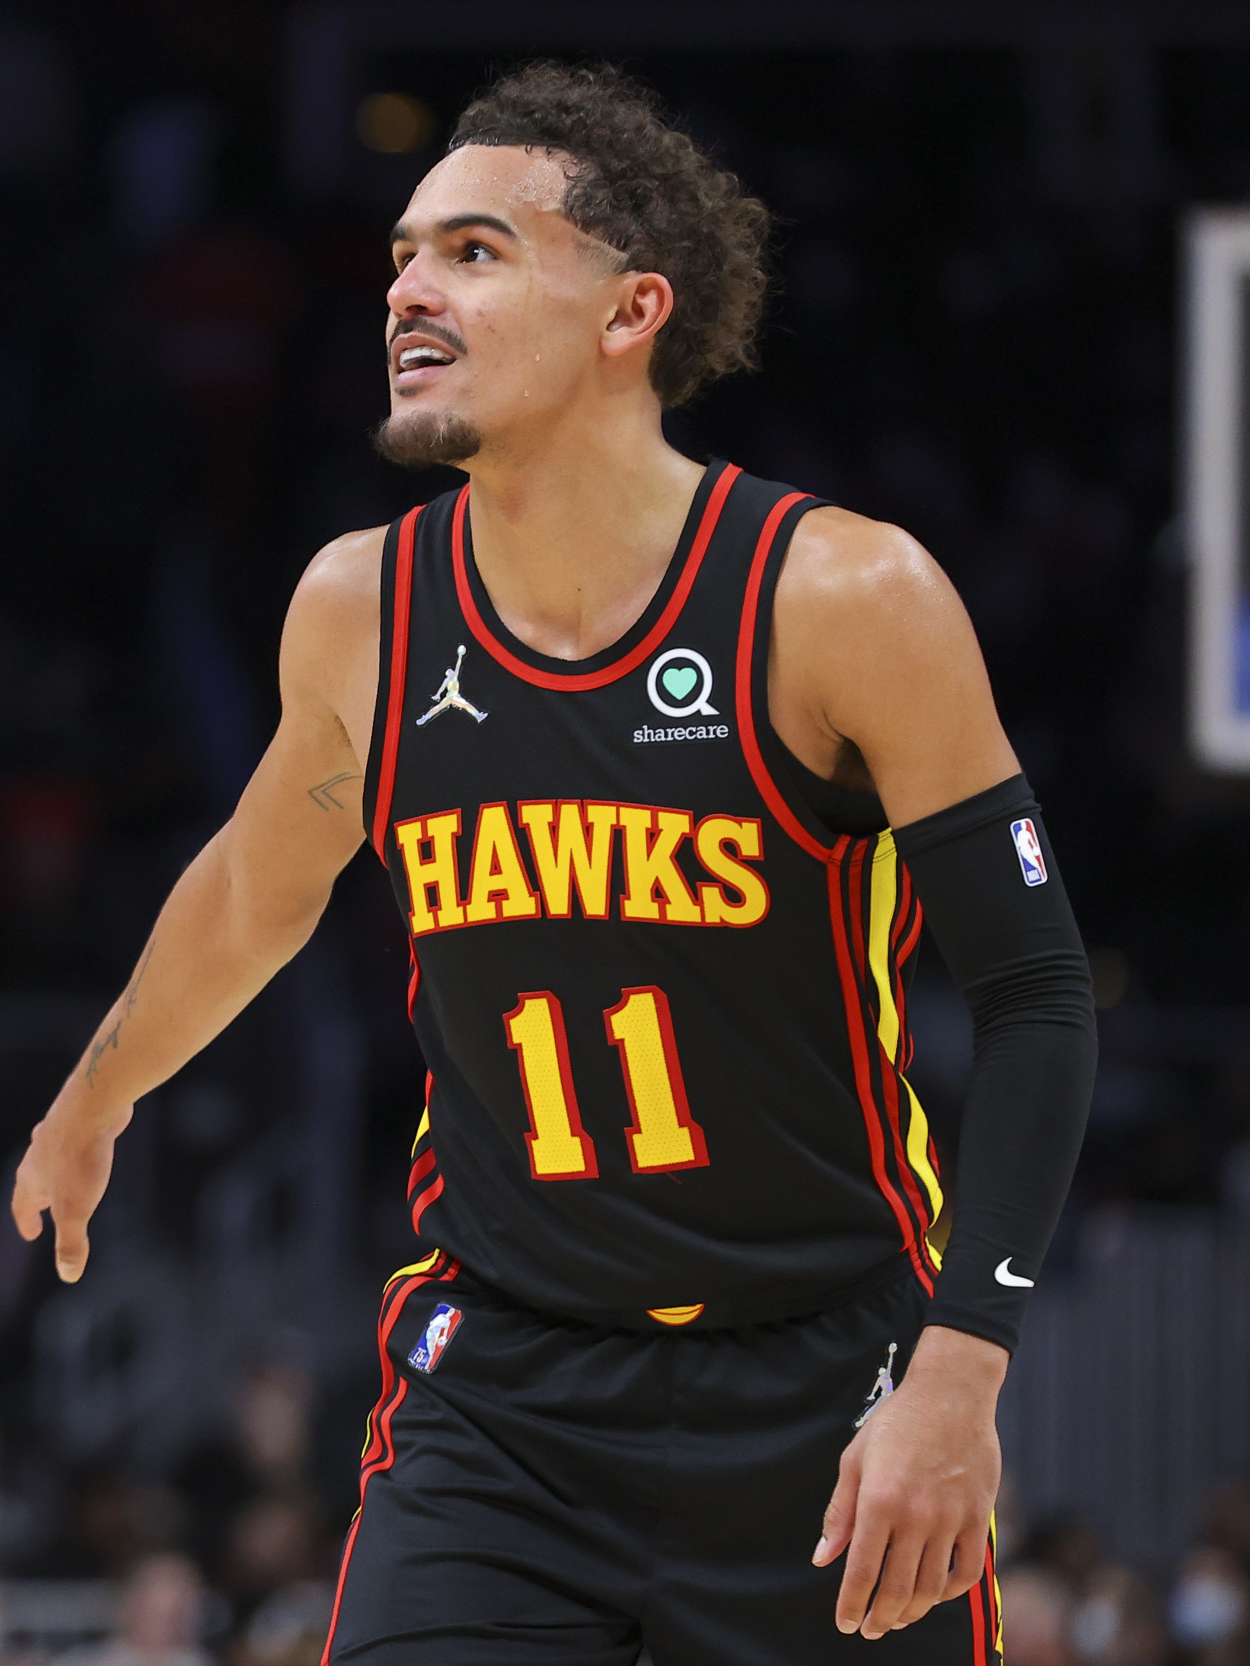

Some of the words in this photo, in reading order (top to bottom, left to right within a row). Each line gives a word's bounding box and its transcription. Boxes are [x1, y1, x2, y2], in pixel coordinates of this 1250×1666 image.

[633, 725, 729, 743] sharecare
[393, 799, 771, 938] HAWKS
[502, 984, 710, 1181] 11
[413, 1346, 427, 1364] 75
